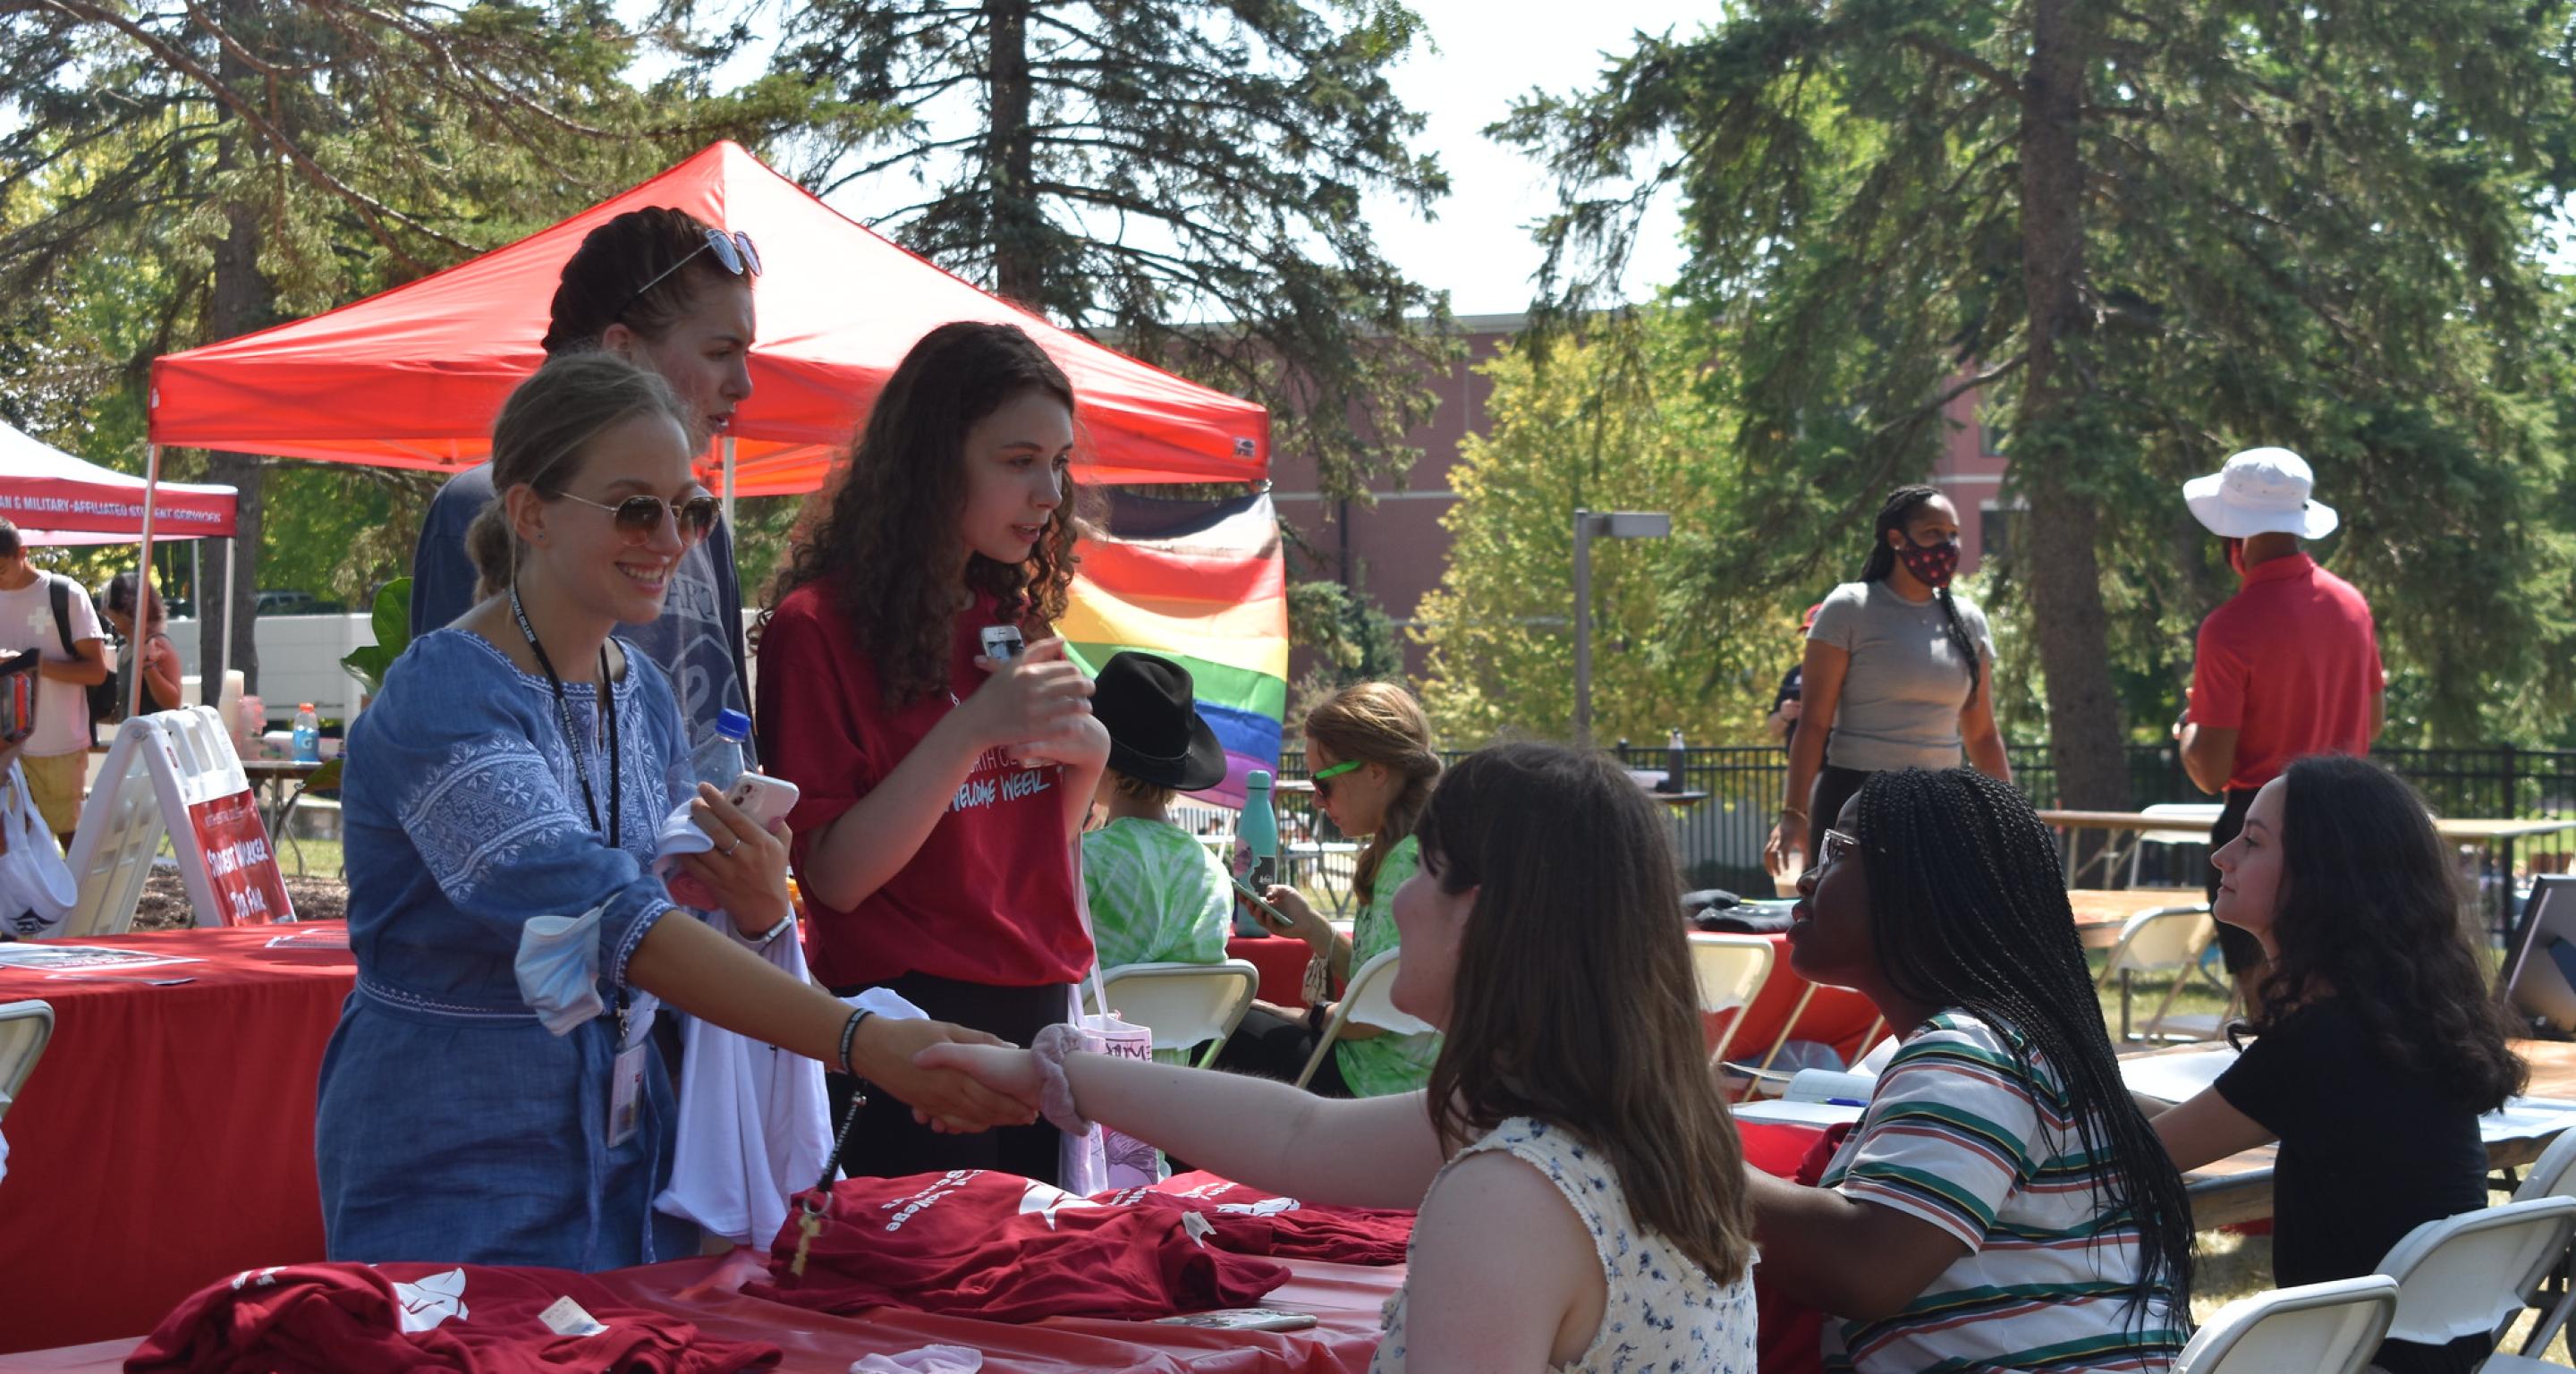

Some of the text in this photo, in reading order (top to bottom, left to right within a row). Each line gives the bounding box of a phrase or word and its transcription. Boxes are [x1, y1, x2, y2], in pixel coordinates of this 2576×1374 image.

[129, 504, 173, 519] STENT
[301, 736, 313, 750] G
[999, 769, 1051, 802] WEEK
